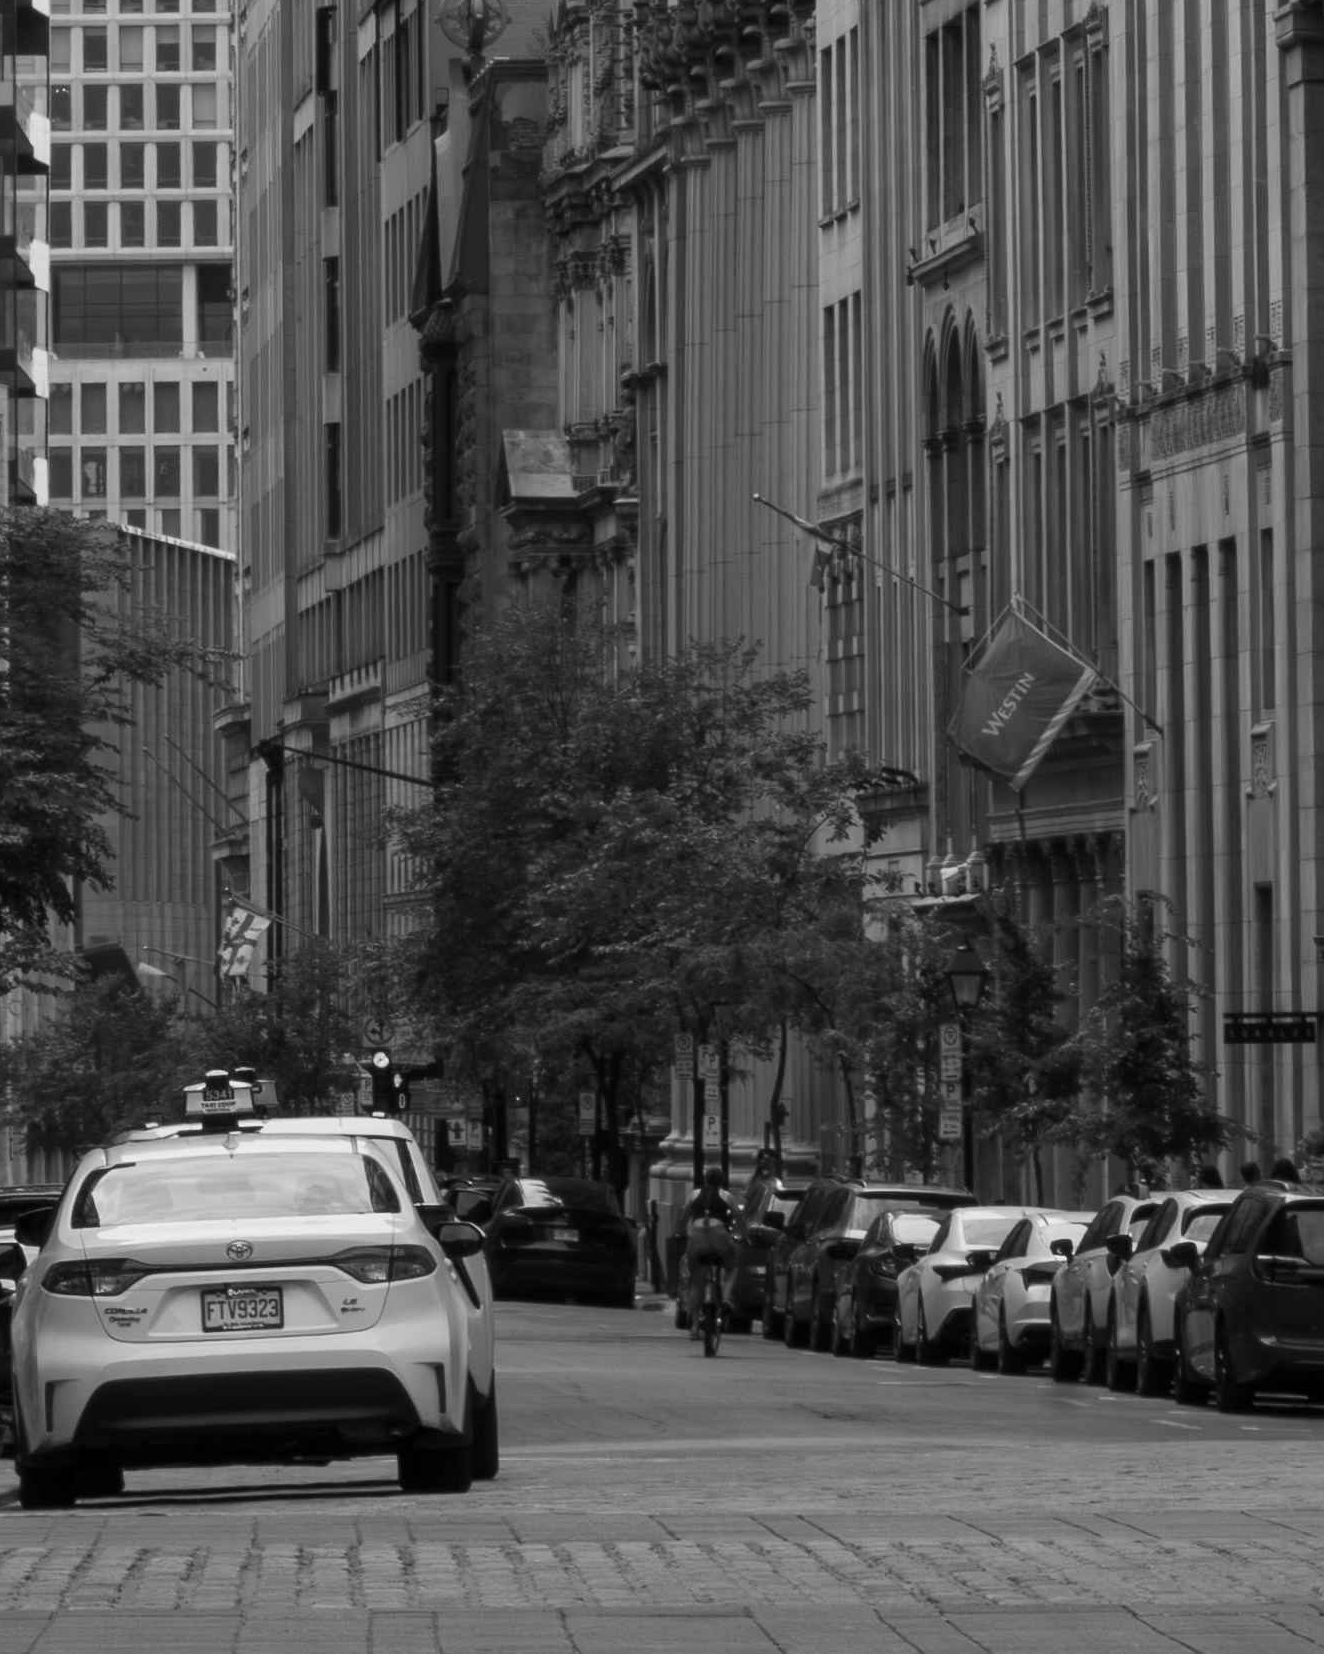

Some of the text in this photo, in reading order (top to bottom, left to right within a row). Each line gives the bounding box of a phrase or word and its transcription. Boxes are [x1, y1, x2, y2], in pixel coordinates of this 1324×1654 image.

[981, 672, 1036, 736] WESTIN
[206, 1090, 234, 1101] 5341
[207, 1298, 279, 1321] FTV9323
